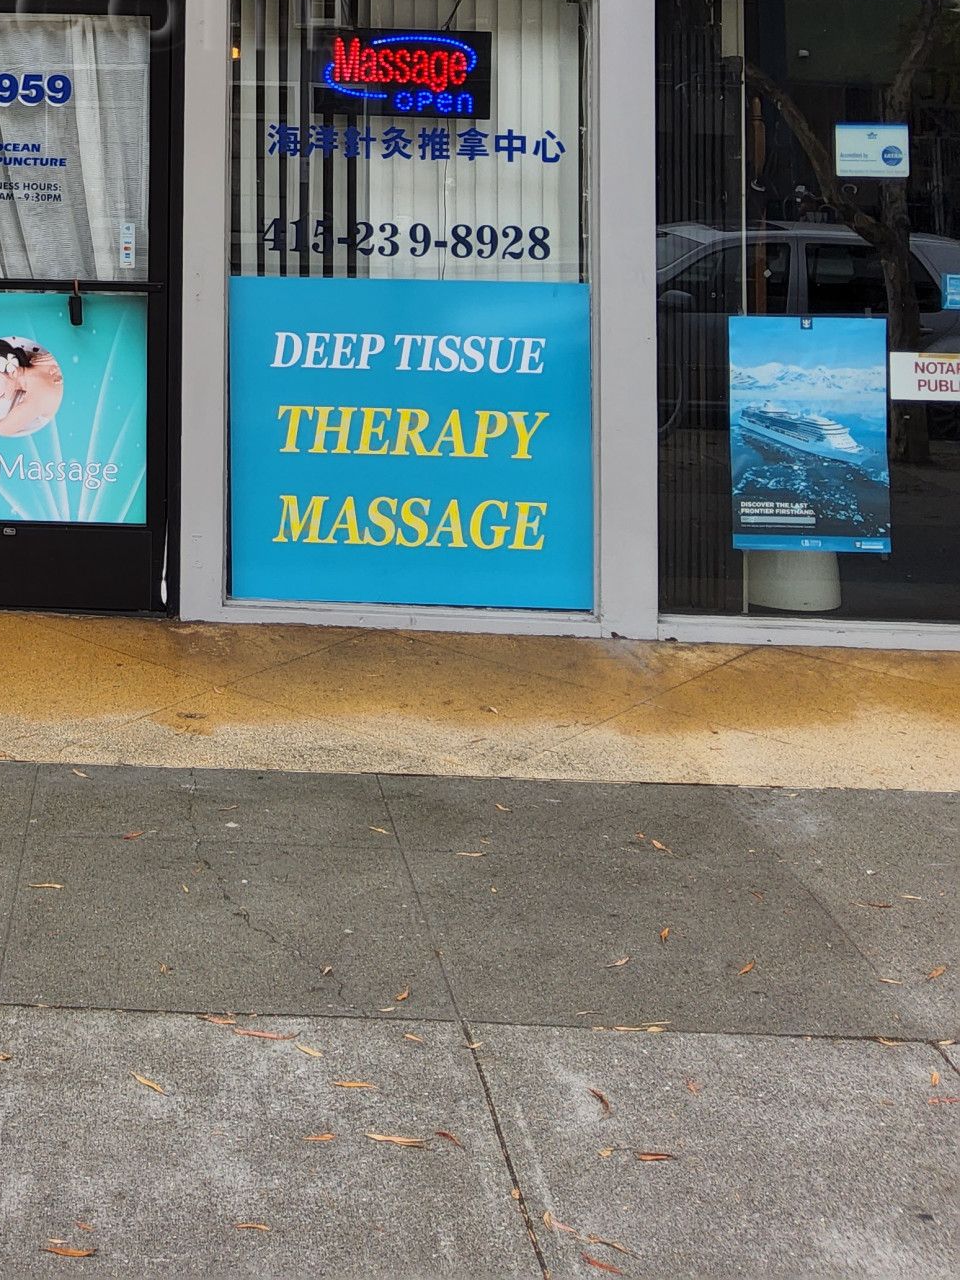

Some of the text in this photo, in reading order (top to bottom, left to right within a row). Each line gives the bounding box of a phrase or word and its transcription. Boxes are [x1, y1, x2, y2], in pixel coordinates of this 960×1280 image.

[333, 37, 467, 92] Massage
[268, 124, 566, 163] 海洋針灸推拿中心
[23, 182, 61, 191] HOURS:
[262, 218, 551, 260] 415-239-8928
[270, 331, 546, 374] DEEP TISSUE
[917, 379, 960, 392] PUBL
[278, 405, 550, 459] THERAPY
[272, 495, 548, 551] MASSAGE
